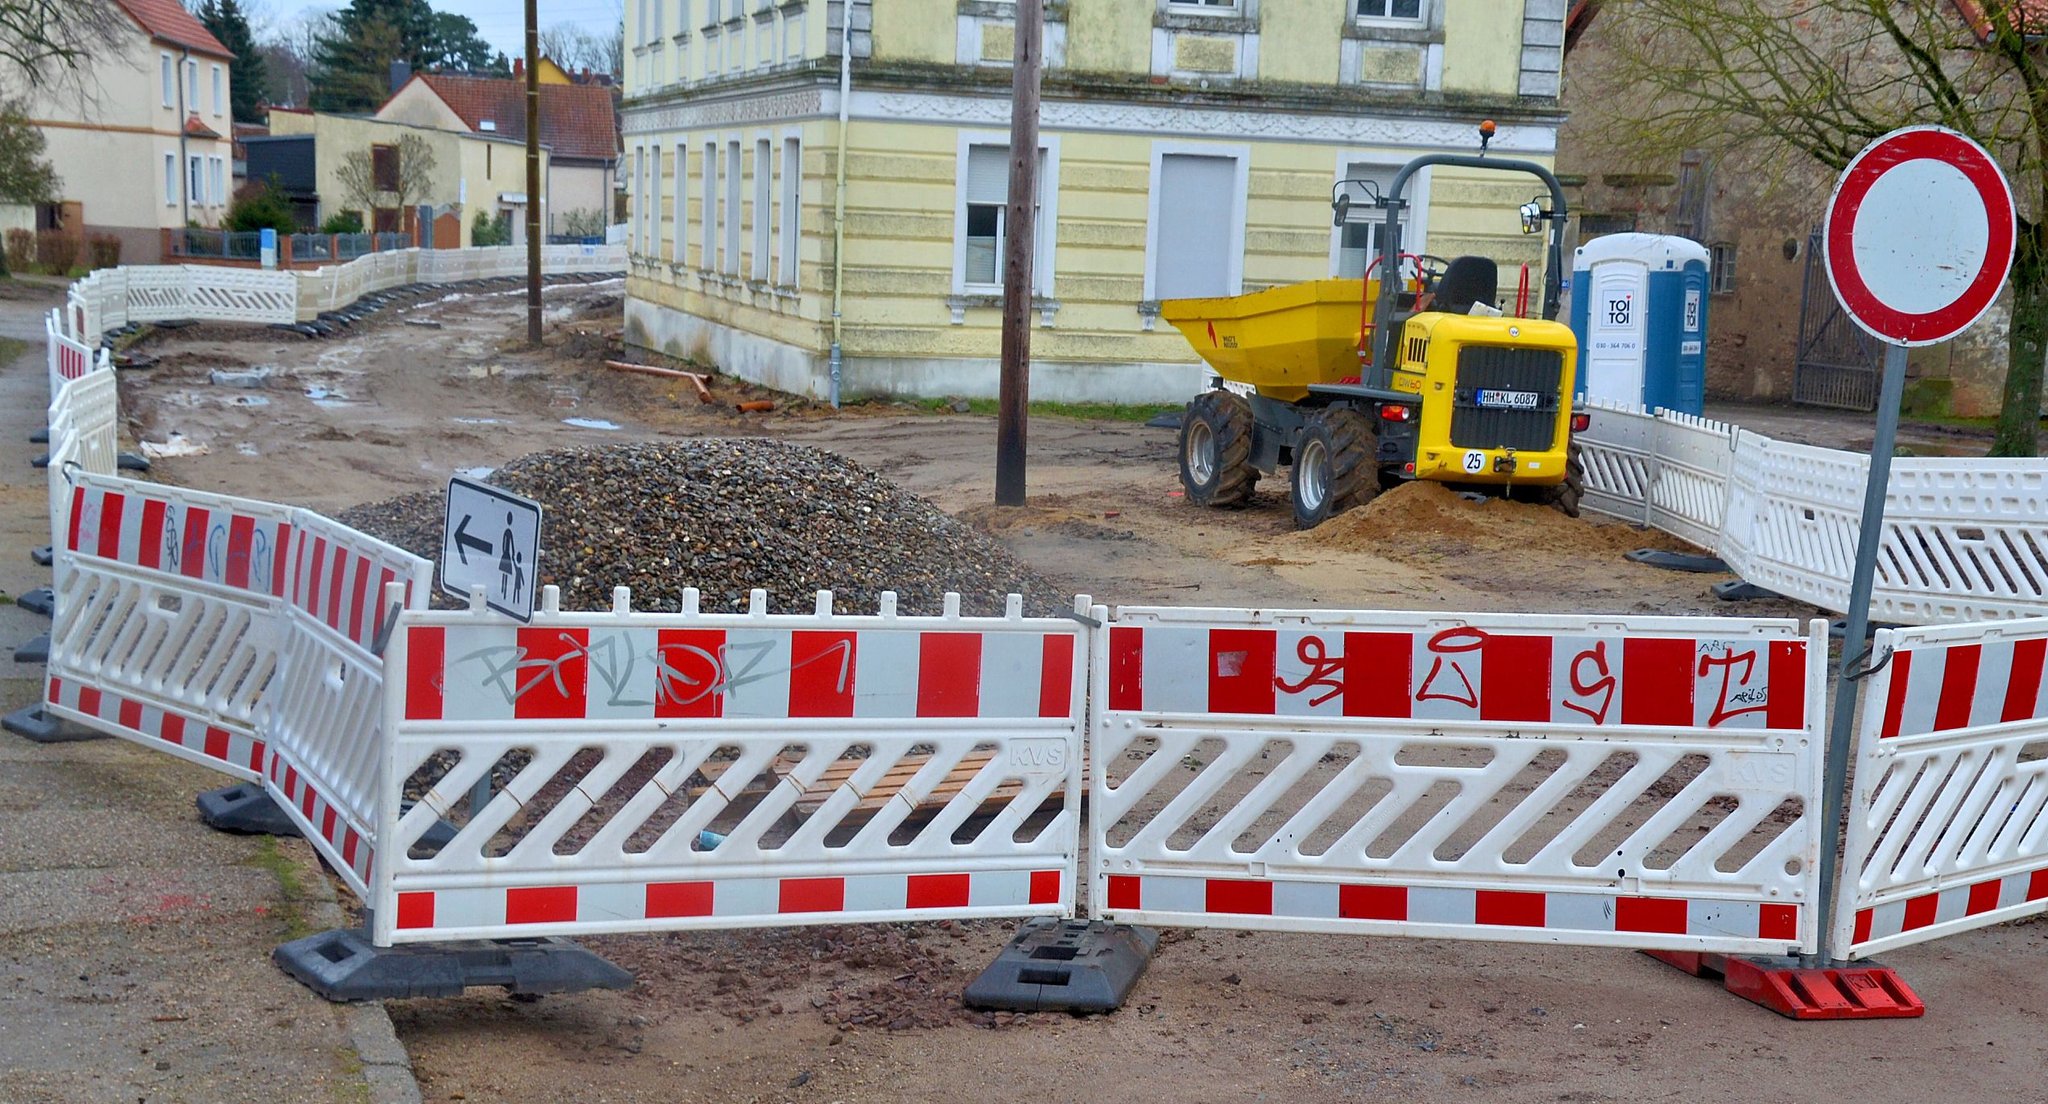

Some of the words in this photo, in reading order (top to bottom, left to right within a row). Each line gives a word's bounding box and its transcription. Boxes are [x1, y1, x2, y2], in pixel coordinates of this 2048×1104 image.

[1609, 299, 1630, 311] TOI
[1609, 312, 1629, 324] TOI
[1482, 391, 1495, 403] HH
[1500, 392, 1512, 404] KL
[1514, 393, 1537, 405] 6087
[1467, 453, 1482, 469] 25
[1009, 745, 1062, 767] KVS
